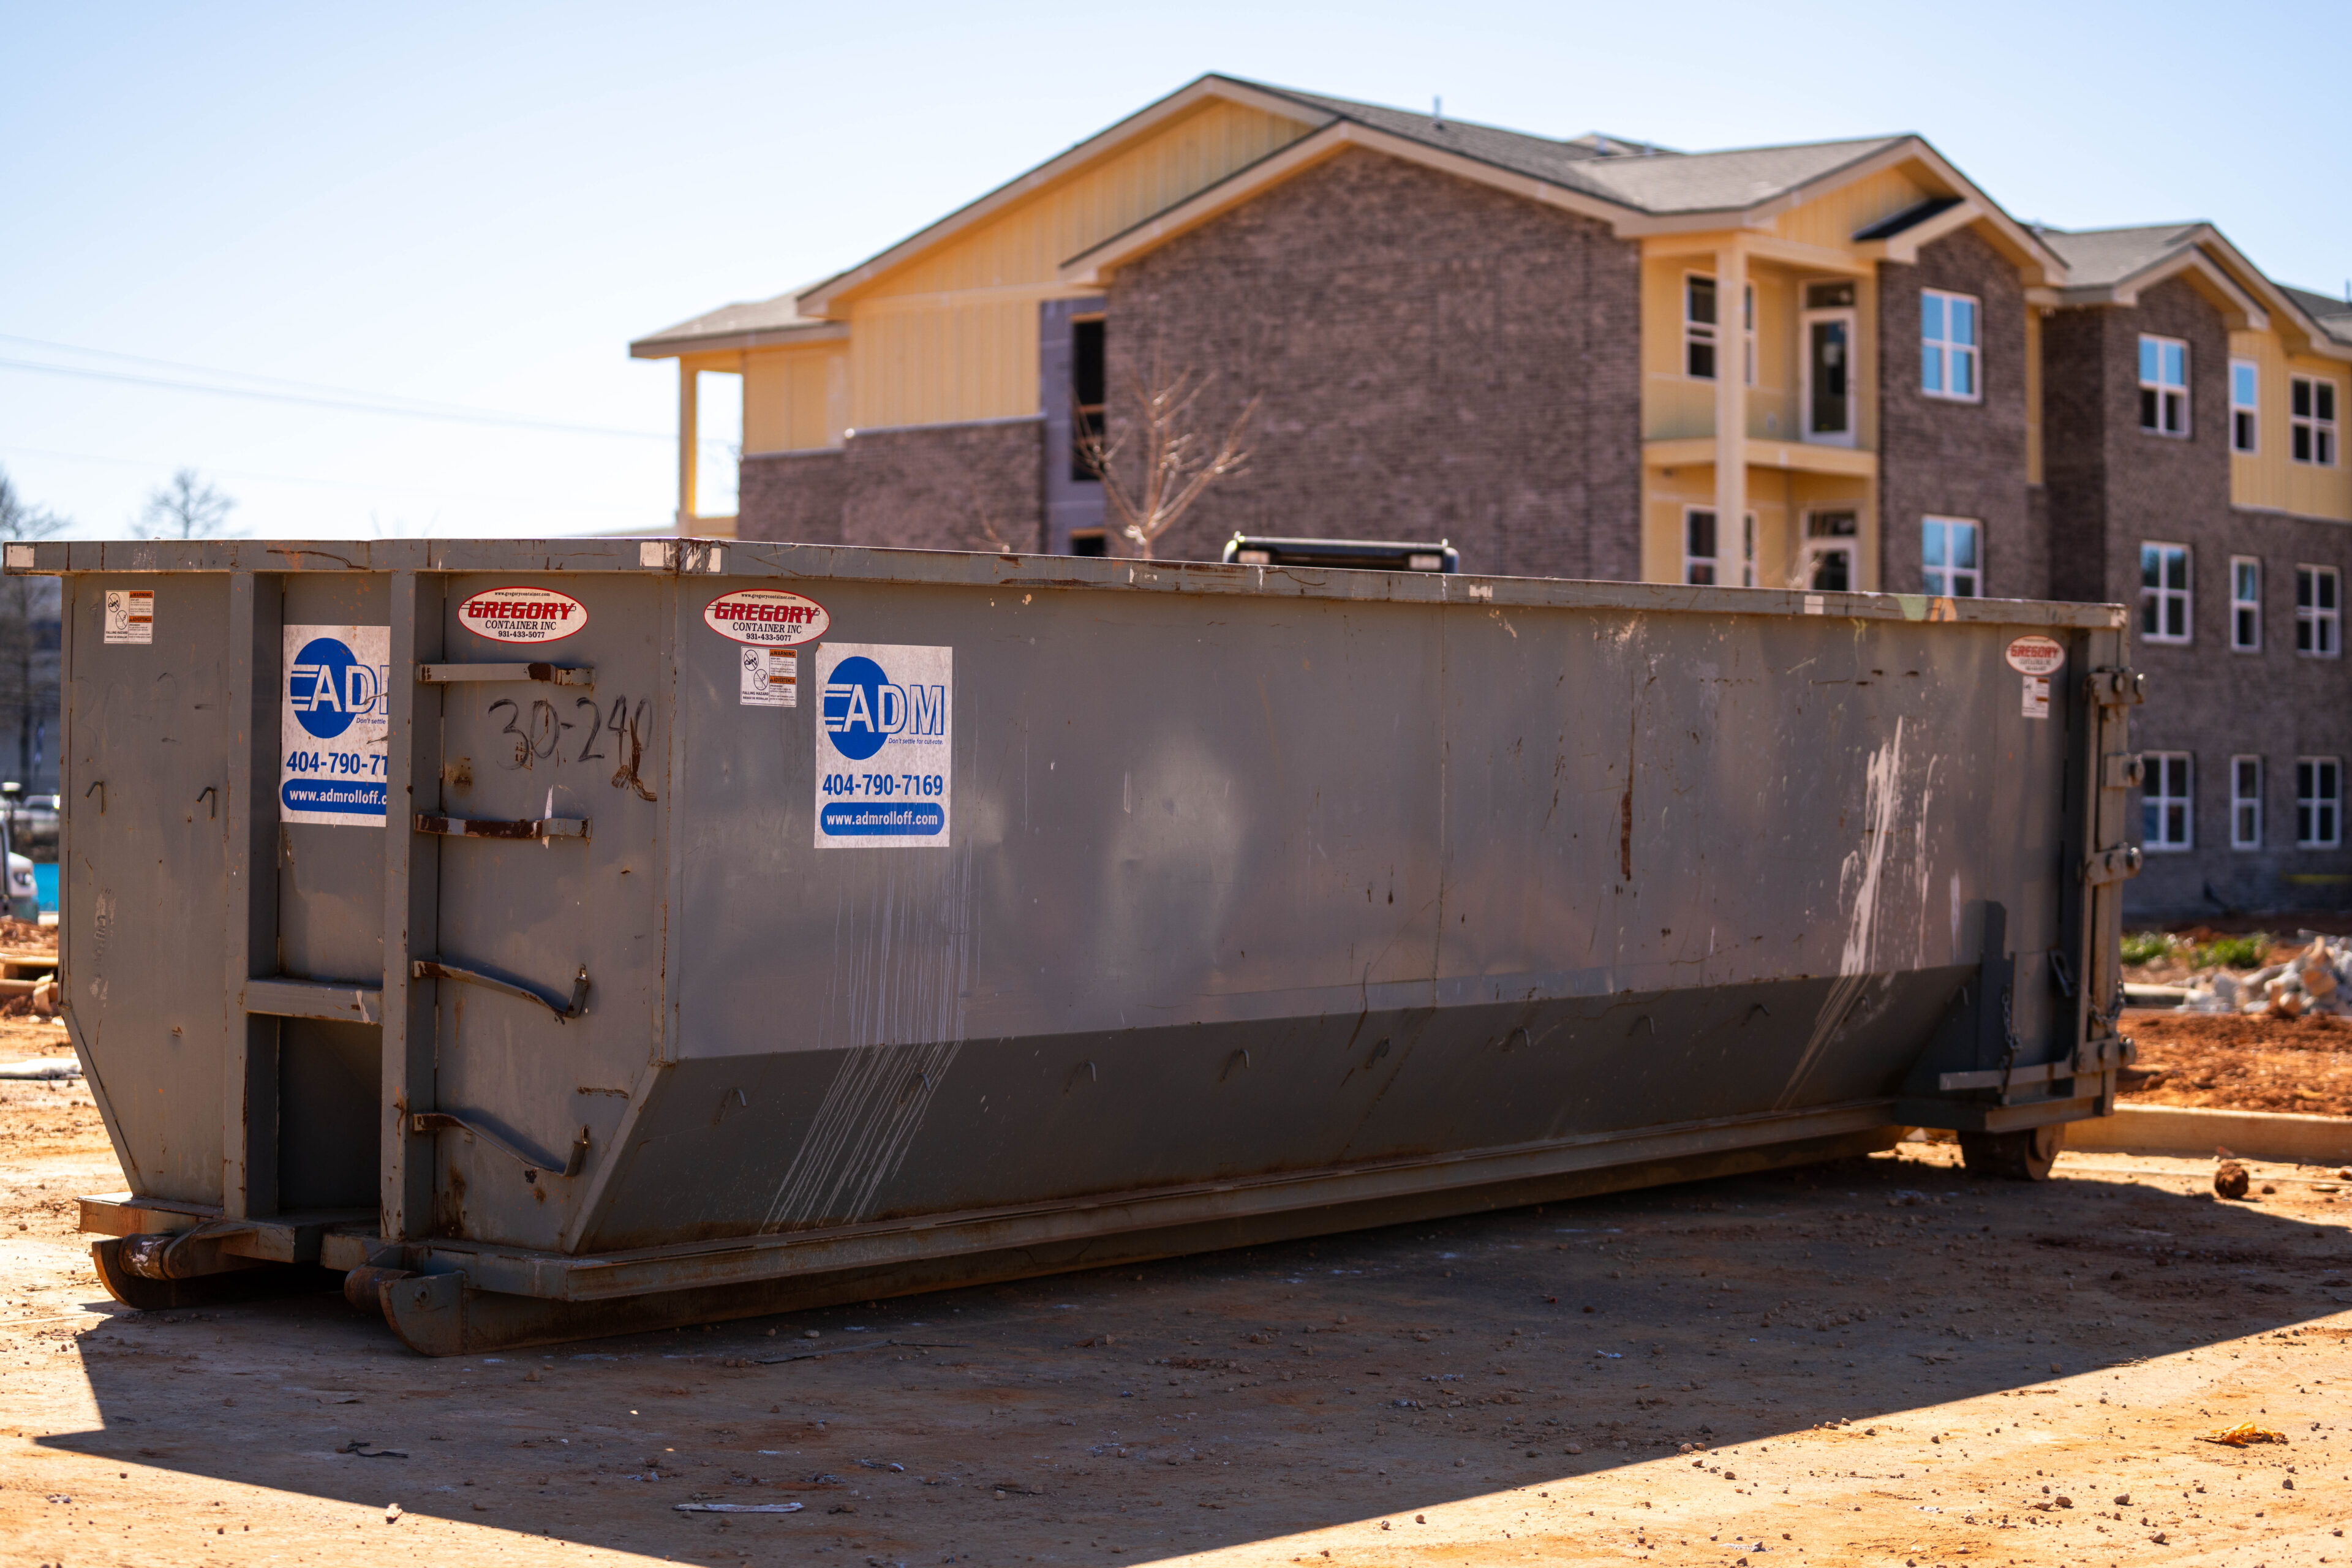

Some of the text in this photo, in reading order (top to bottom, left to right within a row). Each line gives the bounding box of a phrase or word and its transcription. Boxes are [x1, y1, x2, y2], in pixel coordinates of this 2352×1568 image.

[468, 601, 576, 620] GREGORY
[714, 602, 820, 624] GREGORY
[485, 620, 557, 630] CONTAINER INC
[733, 622, 802, 634] CONTAINER INC
[2011, 645, 2058, 658] GREGORY
[843, 684, 944, 735] ADM
[823, 774, 943, 796] 404-790-7169
[827, 811, 938, 826] www.admrolloff.com
